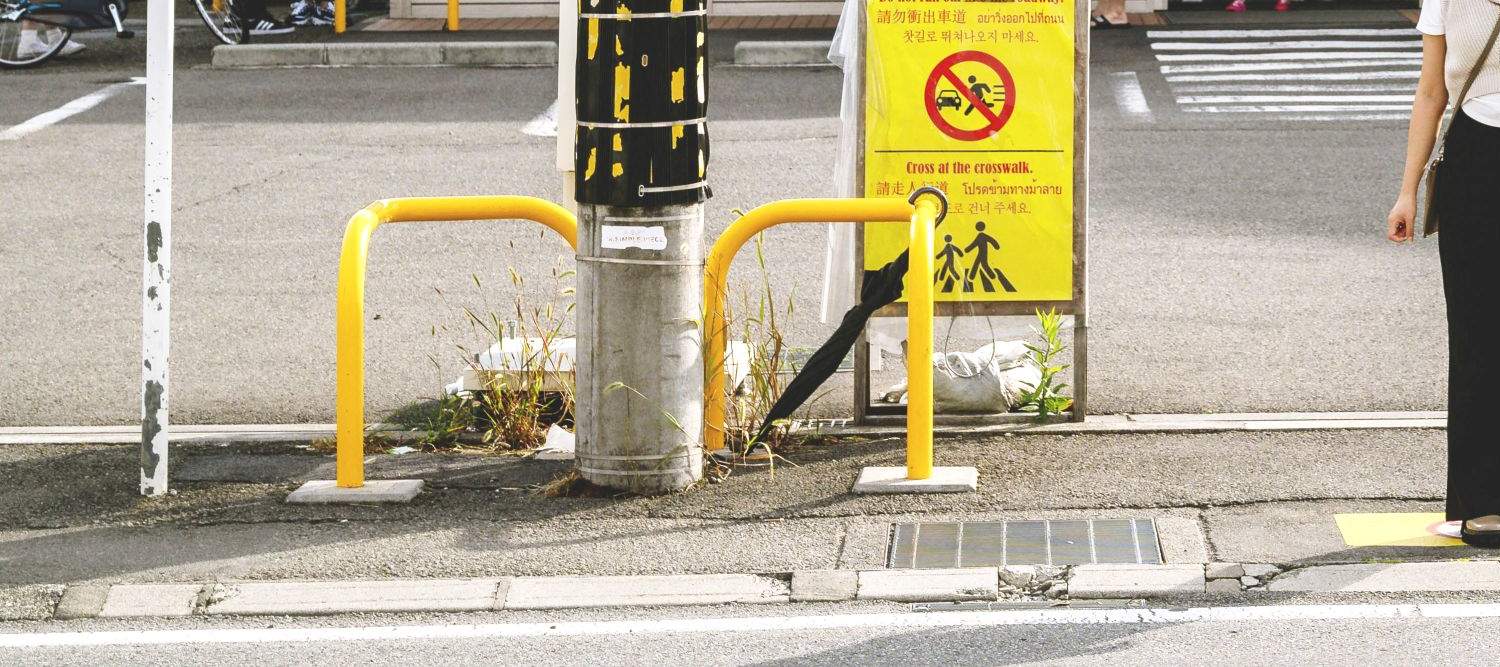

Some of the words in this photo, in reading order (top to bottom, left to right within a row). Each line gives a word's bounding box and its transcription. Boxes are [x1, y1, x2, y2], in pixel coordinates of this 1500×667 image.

[877, 9, 967, 24] 請勿衝出車道
[1002, 29, 1039, 43] 마세요.
[906, 161, 935, 174] Cross
[938, 161, 949, 174] at
[953, 161, 971, 174] the
[974, 161, 1033, 174] crosswalk.
[994, 202, 1032, 214] 주세요.
